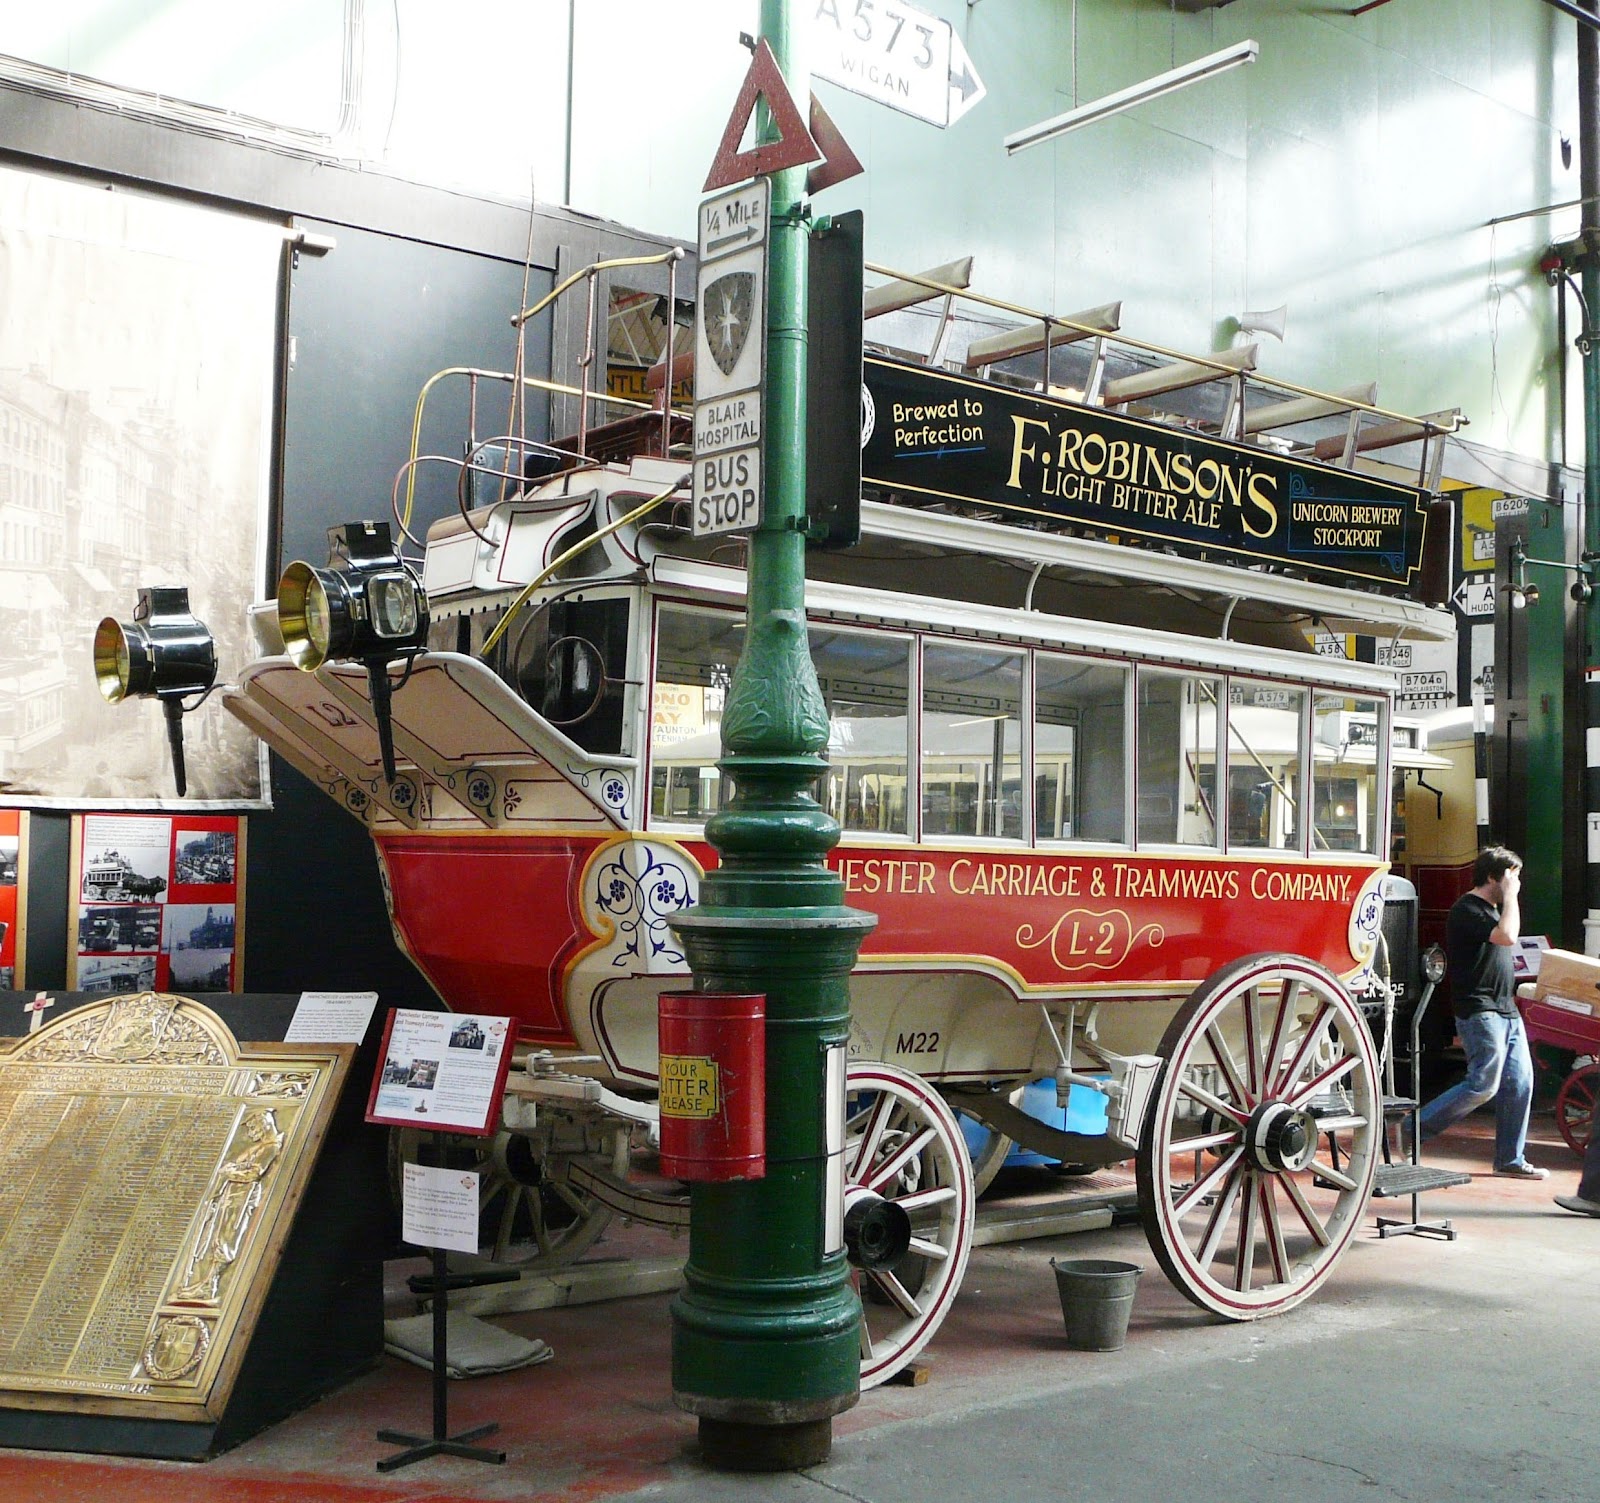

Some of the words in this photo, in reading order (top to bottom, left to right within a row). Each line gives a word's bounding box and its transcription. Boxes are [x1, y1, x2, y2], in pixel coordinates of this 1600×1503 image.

[815, 0, 935, 70] A573
[840, 52, 910, 97] WIGAN
[727, 201, 760, 225] MILE
[708, 401, 746, 425] BLAIR
[893, 399, 958, 423] Brewed
[964, 398, 983, 417] to
[697, 420, 758, 448] HOSPITAL
[895, 425, 983, 448] Perfection
[704, 454, 749, 492] BUS
[697, 488, 755, 528] STOP
[1042, 468, 1106, 505] LIGHT
[1112, 483, 1178, 521] BITTER
[1182, 500, 1222, 529] ALE
[1496, 499, 1530, 511] B6209
[1292, 502, 1348, 523] UNICORN
[1351, 504, 1403, 526] BREWERY
[1313, 527, 1382, 547] STOCKPORT
[1320, 644, 1341, 655] A58
[1258, 691, 1285, 703] A579
[1404, 685, 1445, 693] SINCLAIRSTON
[1410, 701, 1438, 711] A713
[949, 859, 1083, 897] CARRIAGE
[1089, 866, 1107, 898] &
[1112, 863, 1240, 899] TRAMWAYS
[896, 1031, 940, 1054] M22
[664, 1062, 697, 1077] YOUR
[660, 1079, 710, 1096] LITTER
[663, 1097, 702, 1111] PLEASE
